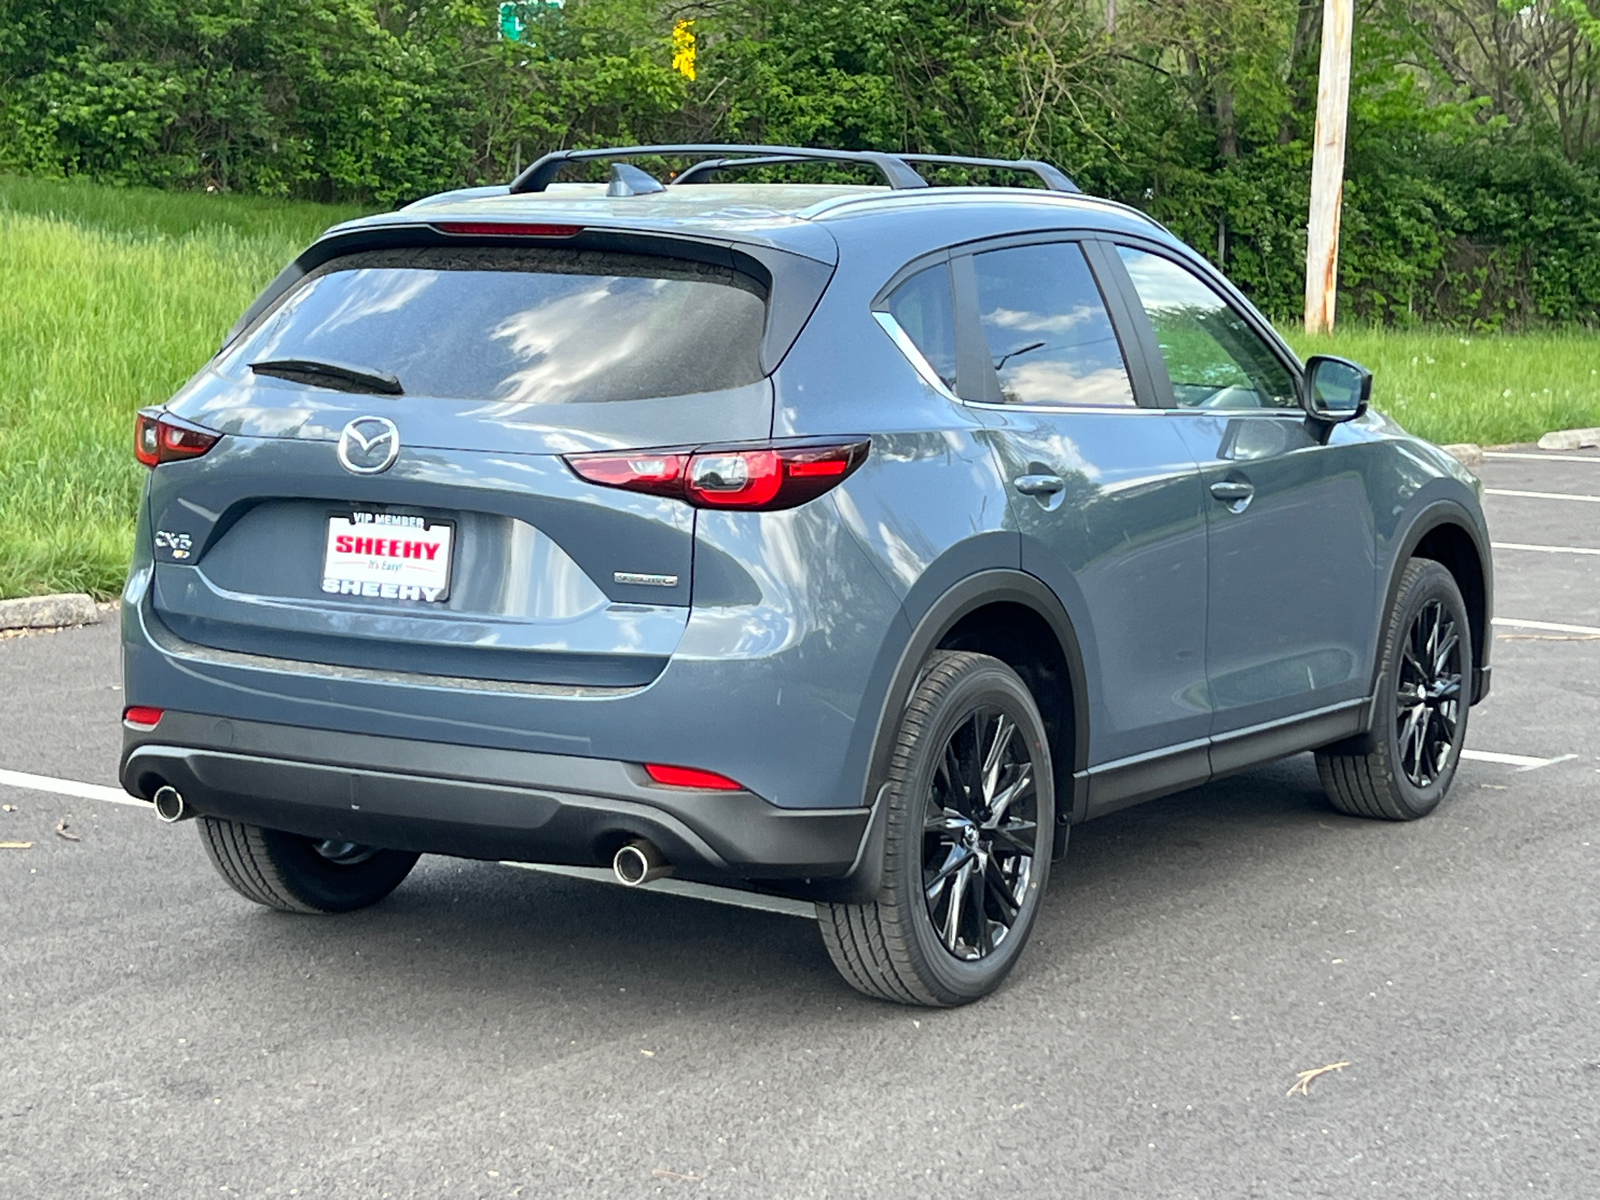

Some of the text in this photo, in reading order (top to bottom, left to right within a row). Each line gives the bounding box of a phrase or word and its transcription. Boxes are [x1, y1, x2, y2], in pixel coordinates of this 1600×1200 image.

[353, 512, 425, 528] VIP MEMBER
[335, 535, 441, 560] SHEEHY
[368, 560, 403, 573] It's Easy!
[322, 578, 442, 602] SHEEHY
